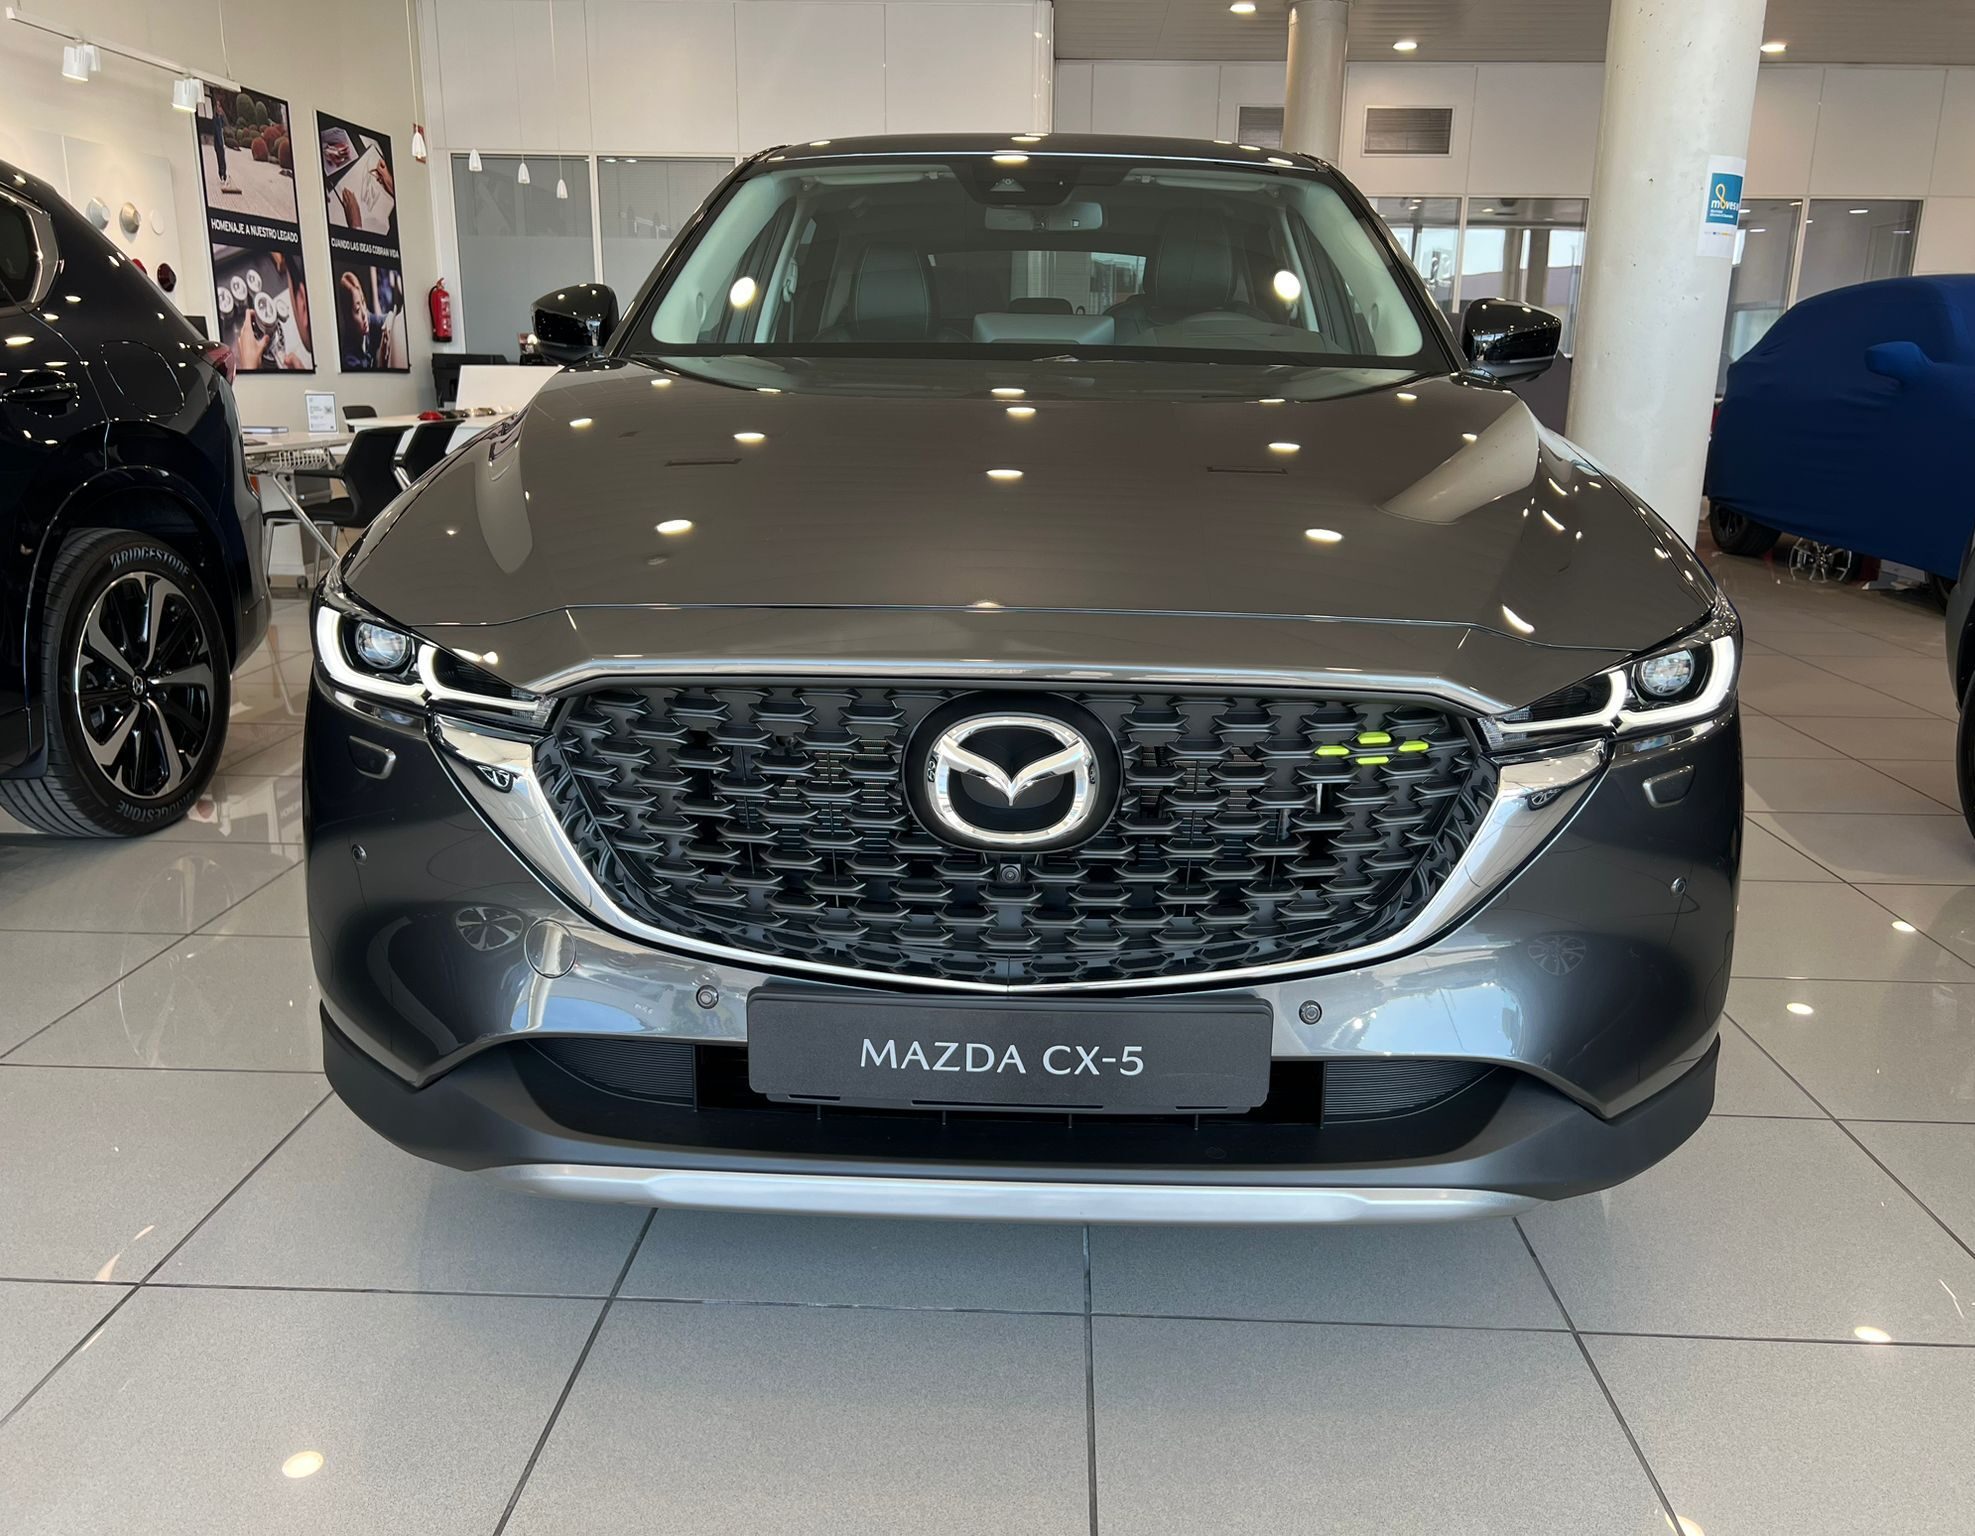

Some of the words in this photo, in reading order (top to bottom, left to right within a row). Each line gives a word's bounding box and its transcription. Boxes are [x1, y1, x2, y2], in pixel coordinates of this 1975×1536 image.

[210, 218, 245, 235] HOMENAJE
[245, 224, 251, 235] A
[250, 225, 277, 240] NUESTRO
[276, 229, 299, 244] LEGADO
[331, 237, 350, 251] CUANDO
[350, 240, 359, 252] LAS
[359, 242, 372, 255] IDEAS
[372, 244, 389, 257] COBRAN
[389, 247, 400, 259] VIDA
[109, 546, 190, 577] BRIDGESTONE
[860, 1038, 1027, 1074] MAZDA
[1042, 1044, 1145, 1076] CX-5
